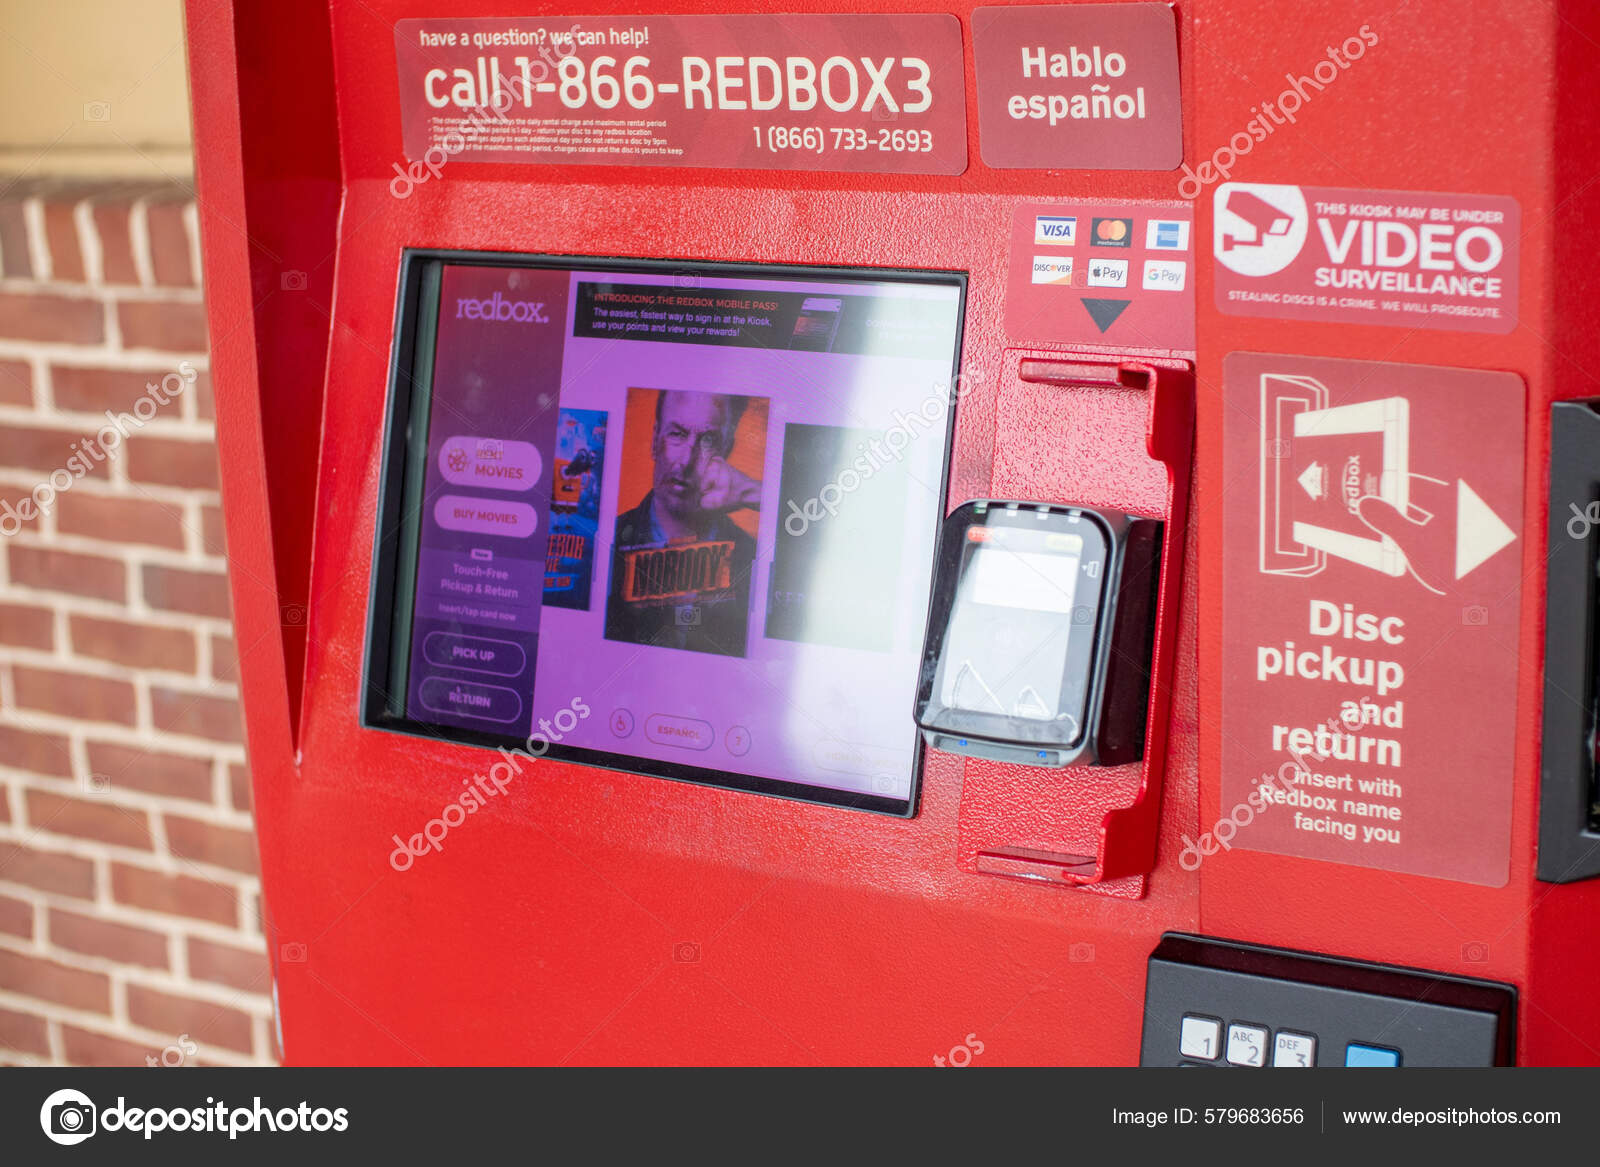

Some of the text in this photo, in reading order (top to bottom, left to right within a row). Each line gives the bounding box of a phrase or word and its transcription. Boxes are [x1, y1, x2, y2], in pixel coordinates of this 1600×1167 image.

[420, 26, 649, 49] have a question? we can help!
[1021, 46, 1126, 78] Hablo
[424, 56, 933, 113] call 1-866-REDBOX3
[1008, 84, 1146, 126] español
[627, 128, 652, 136] location
[646, 120, 667, 128] period
[753, 126, 933, 153] 1 (866) 733-2693
[1315, 202, 1504, 224] THIS KIOSK MAY BE UNDER
[1042, 224, 1071, 237] VISA
[1317, 218, 1503, 273] VIDEO
[1102, 267, 1124, 280] Pay
[1161, 270, 1182, 284] Pay
[1315, 267, 1502, 298] SURVEILLANCE
[594, 293, 654, 304] INTRODUCING
[657, 296, 674, 304] THE
[676, 297, 713, 307] REDBOX
[716, 300, 751, 309] MOBILE
[1228, 290, 1280, 303] STEALING
[1282, 294, 1315, 305] DISCS
[1316, 296, 1328, 306] IS
[1328, 297, 1338, 306] A
[1340, 298, 1376, 310] CRIME.
[1382, 301, 1400, 311] WE
[1402, 302, 1430, 313] WILL
[594, 307, 608, 316] The
[668, 313, 684, 322] way
[686, 313, 693, 321] to
[696, 314, 712, 324] sign
[714, 315, 721, 323] in
[732, 316, 746, 324] the
[608, 322, 624, 331] your
[626, 322, 648, 332] points
[650, 324, 666, 332] and
[667, 325, 684, 333] view
[686, 327, 704, 336] your
[706, 328, 740, 336] rewards!
[475, 464, 523, 480] MOVIES
[454, 508, 518, 524] BUY MOVIES
[454, 563, 508, 580] Touch-Free
[441, 578, 518, 598] Pickup & Return
[1310, 600, 1405, 645] Disc
[453, 646, 495, 662] PICK UP
[1257, 641, 1404, 696] pickup
[449, 692, 491, 708] RETURN
[1340, 700, 1404, 728] and
[1272, 724, 1401, 767] return
[1358, 776, 1402, 798] with
[1259, 785, 1401, 820] Redbox name
[1294, 812, 1400, 844] facing you
[1232, 1032, 1254, 1042] ABC
[1278, 1038, 1299, 1049] DEF
[1203, 1038, 1210, 1055] 1
[1248, 1046, 1258, 1064] 2
[1296, 1054, 1306, 1067] 3
